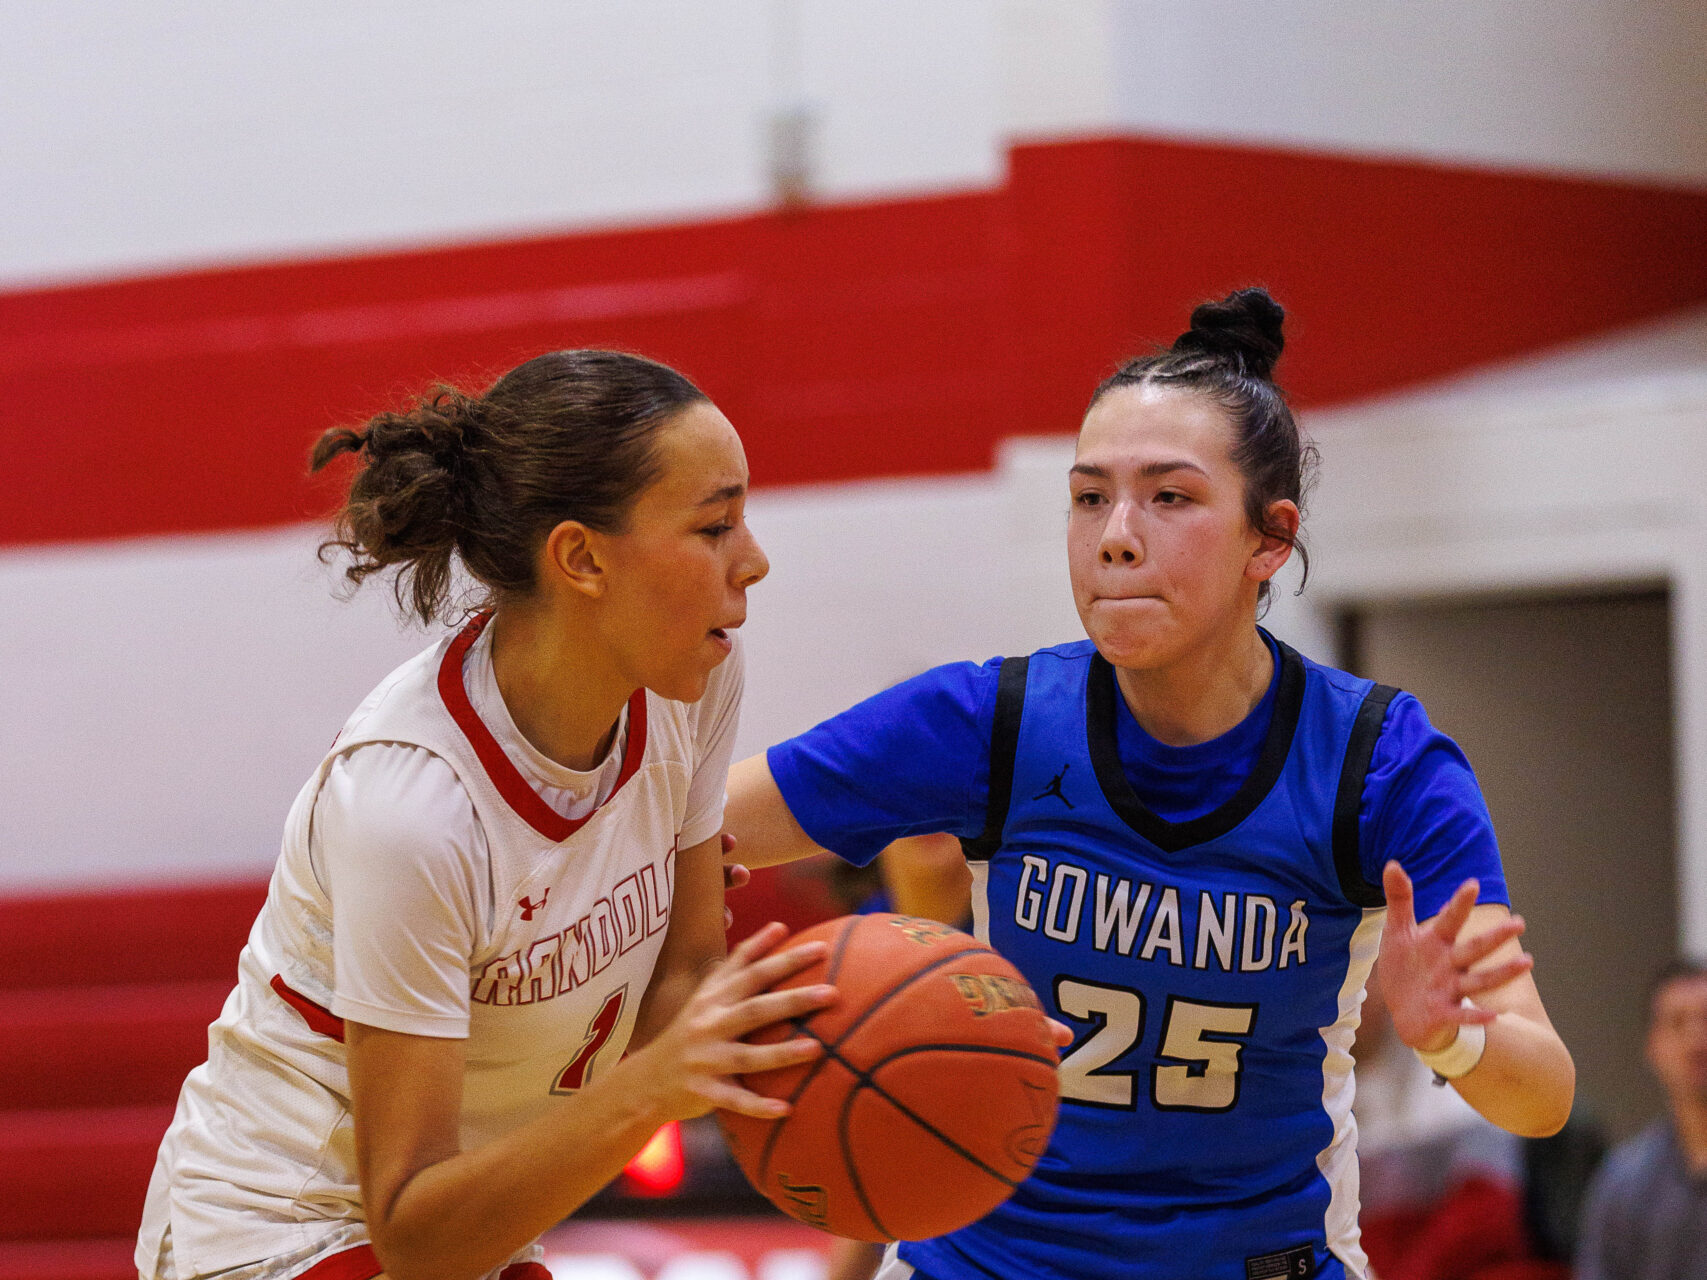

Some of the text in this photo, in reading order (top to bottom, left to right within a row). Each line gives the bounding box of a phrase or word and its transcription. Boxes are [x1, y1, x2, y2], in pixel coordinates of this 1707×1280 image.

[1015, 853, 1310, 972] GOWANDA
[549, 981, 629, 1096] 1
[1053, 974, 1259, 1113] 25
[1297, 1257, 1307, 1275] S
